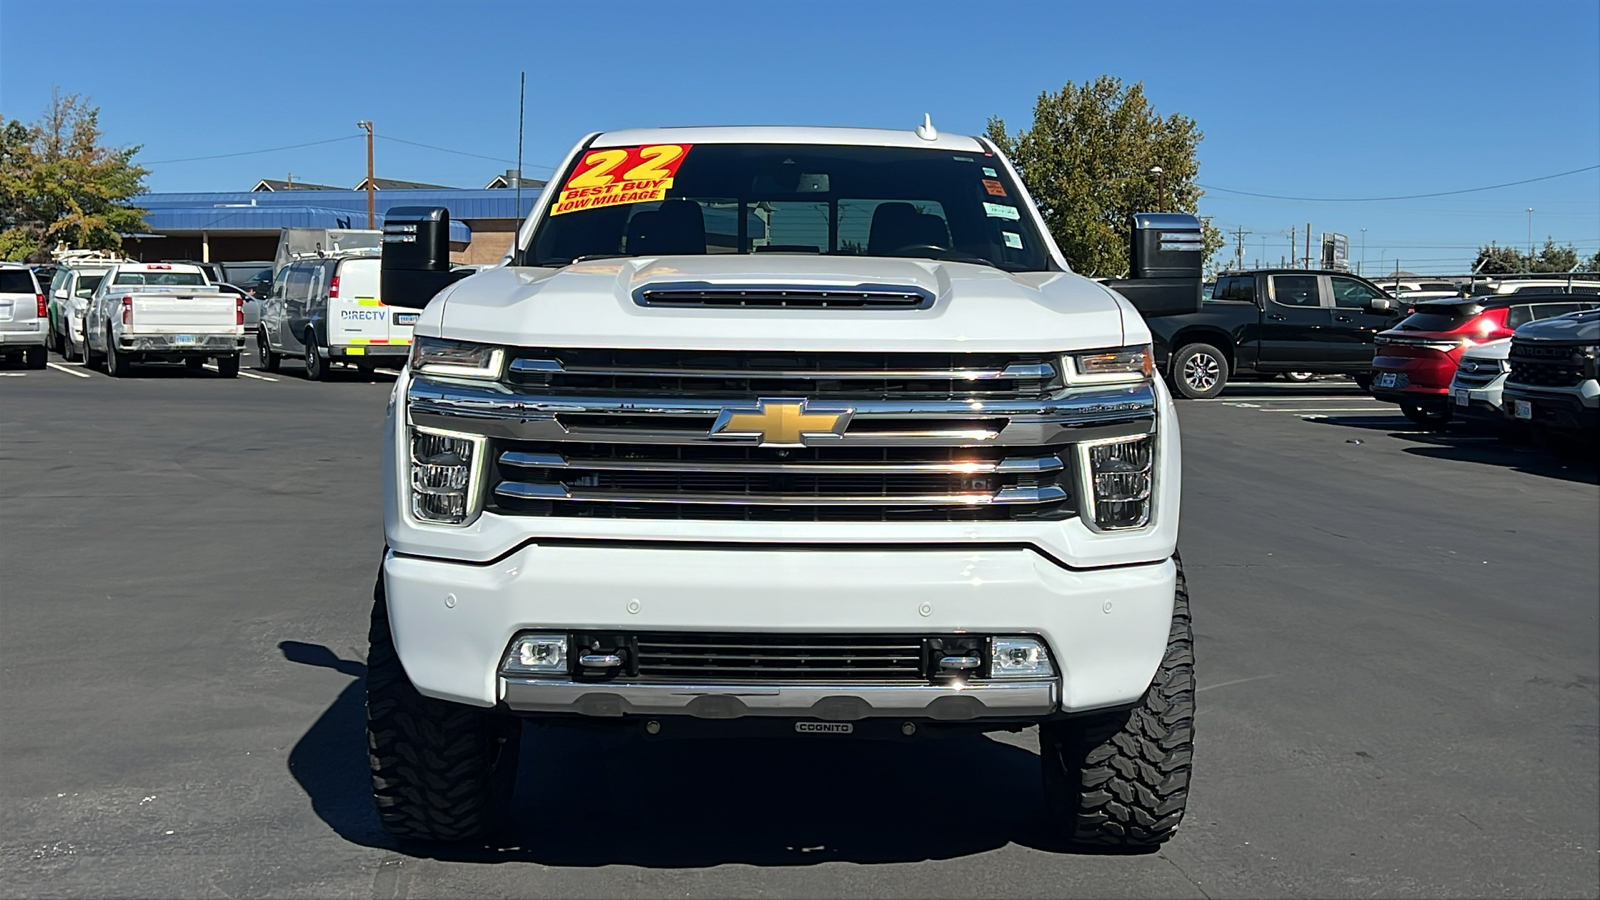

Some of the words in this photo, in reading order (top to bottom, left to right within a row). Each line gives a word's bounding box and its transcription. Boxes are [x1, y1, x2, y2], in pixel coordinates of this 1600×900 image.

[568, 145, 683, 189] 22
[565, 185, 619, 201] BEST
[621, 180, 665, 192] BUY
[556, 200, 590, 213] LOW
[591, 190, 661, 206] MILEAGE
[341, 310, 385, 320] DIRECTV
[799, 723, 849, 732] COGNITO
